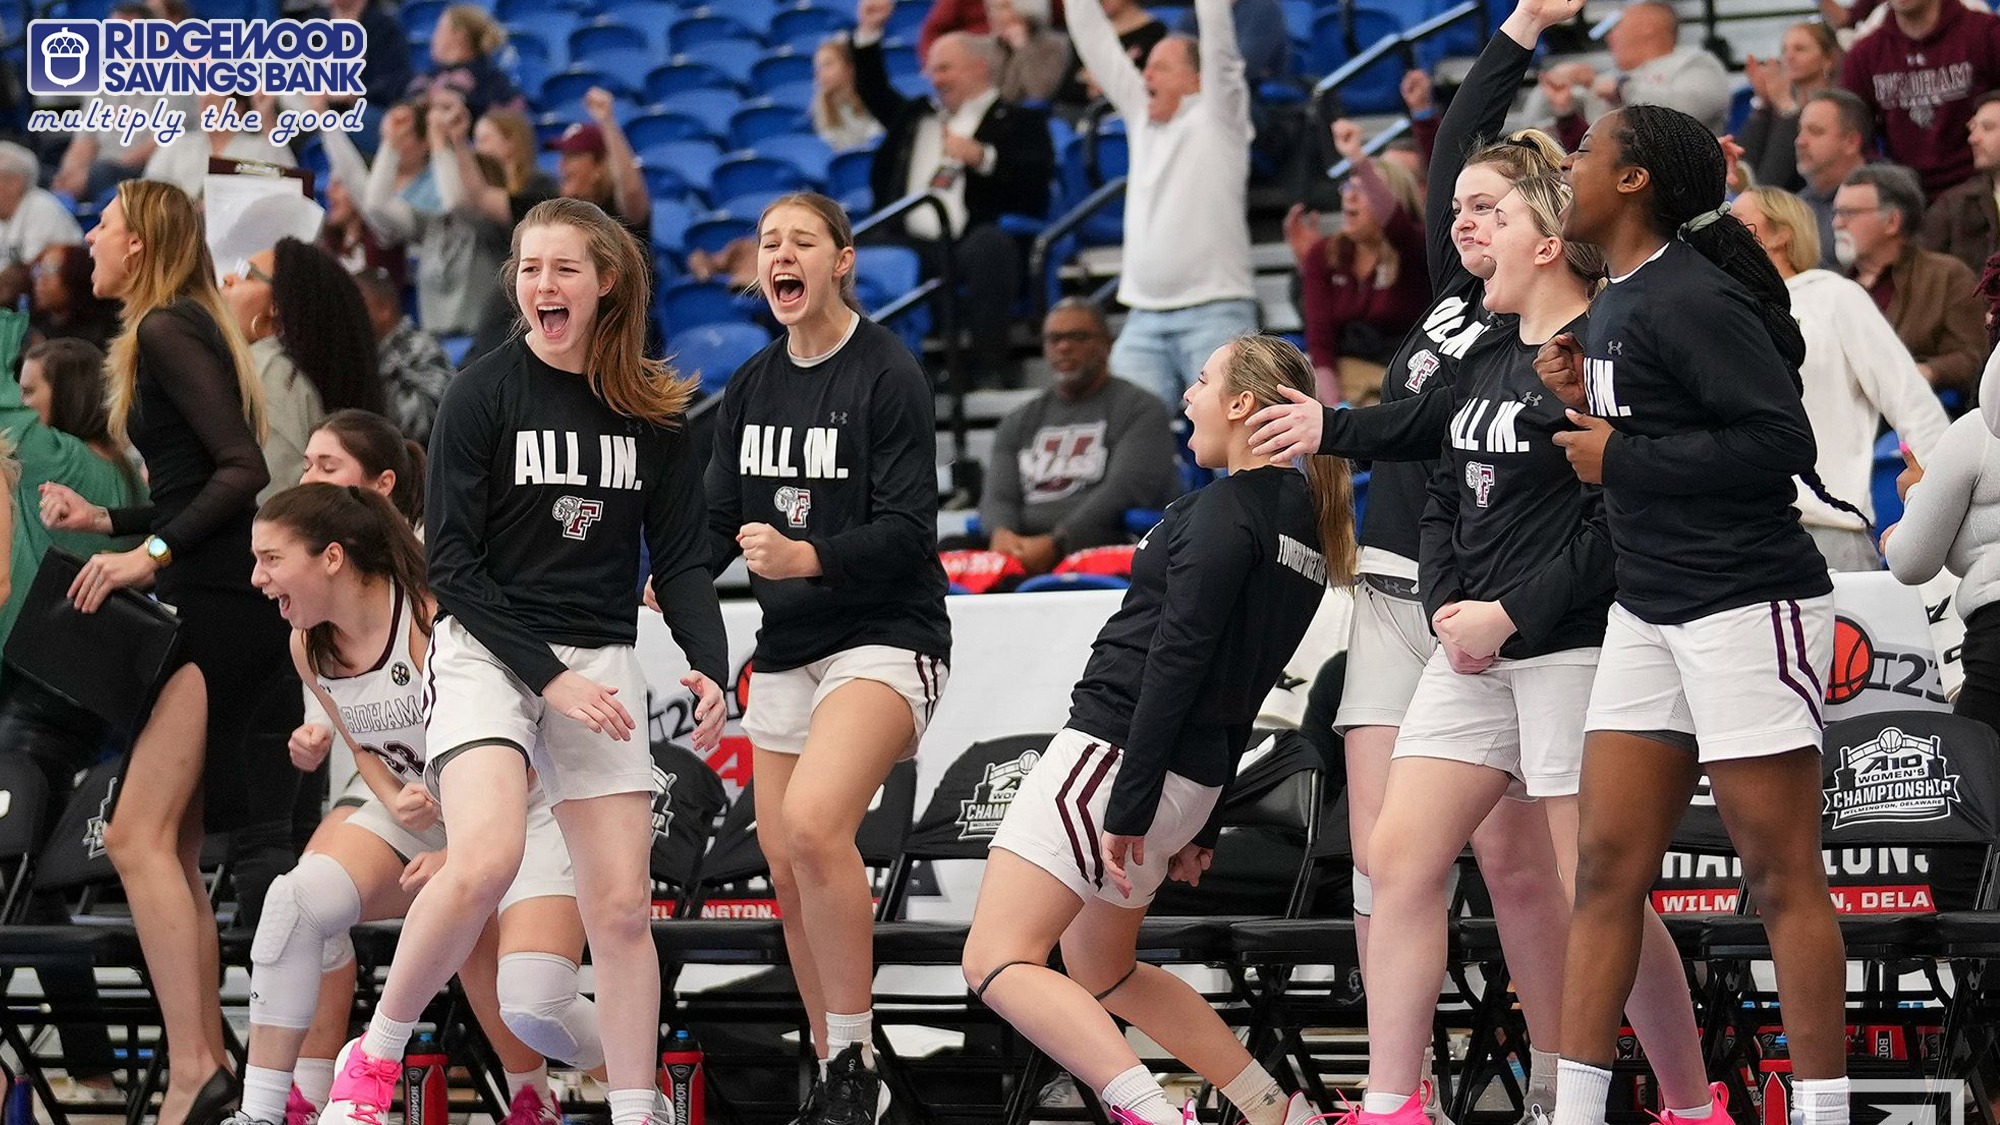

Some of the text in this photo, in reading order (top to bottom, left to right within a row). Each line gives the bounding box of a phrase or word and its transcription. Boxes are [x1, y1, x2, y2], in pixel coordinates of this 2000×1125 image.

[515, 430, 643, 491] ALL IN.
[740, 424, 849, 479] ALL IN.
[1858, 767, 1926, 784] WOMEN'S
[1860, 754, 1923, 775] A10
[1833, 778, 1951, 809] CHAMPIONSHIP
